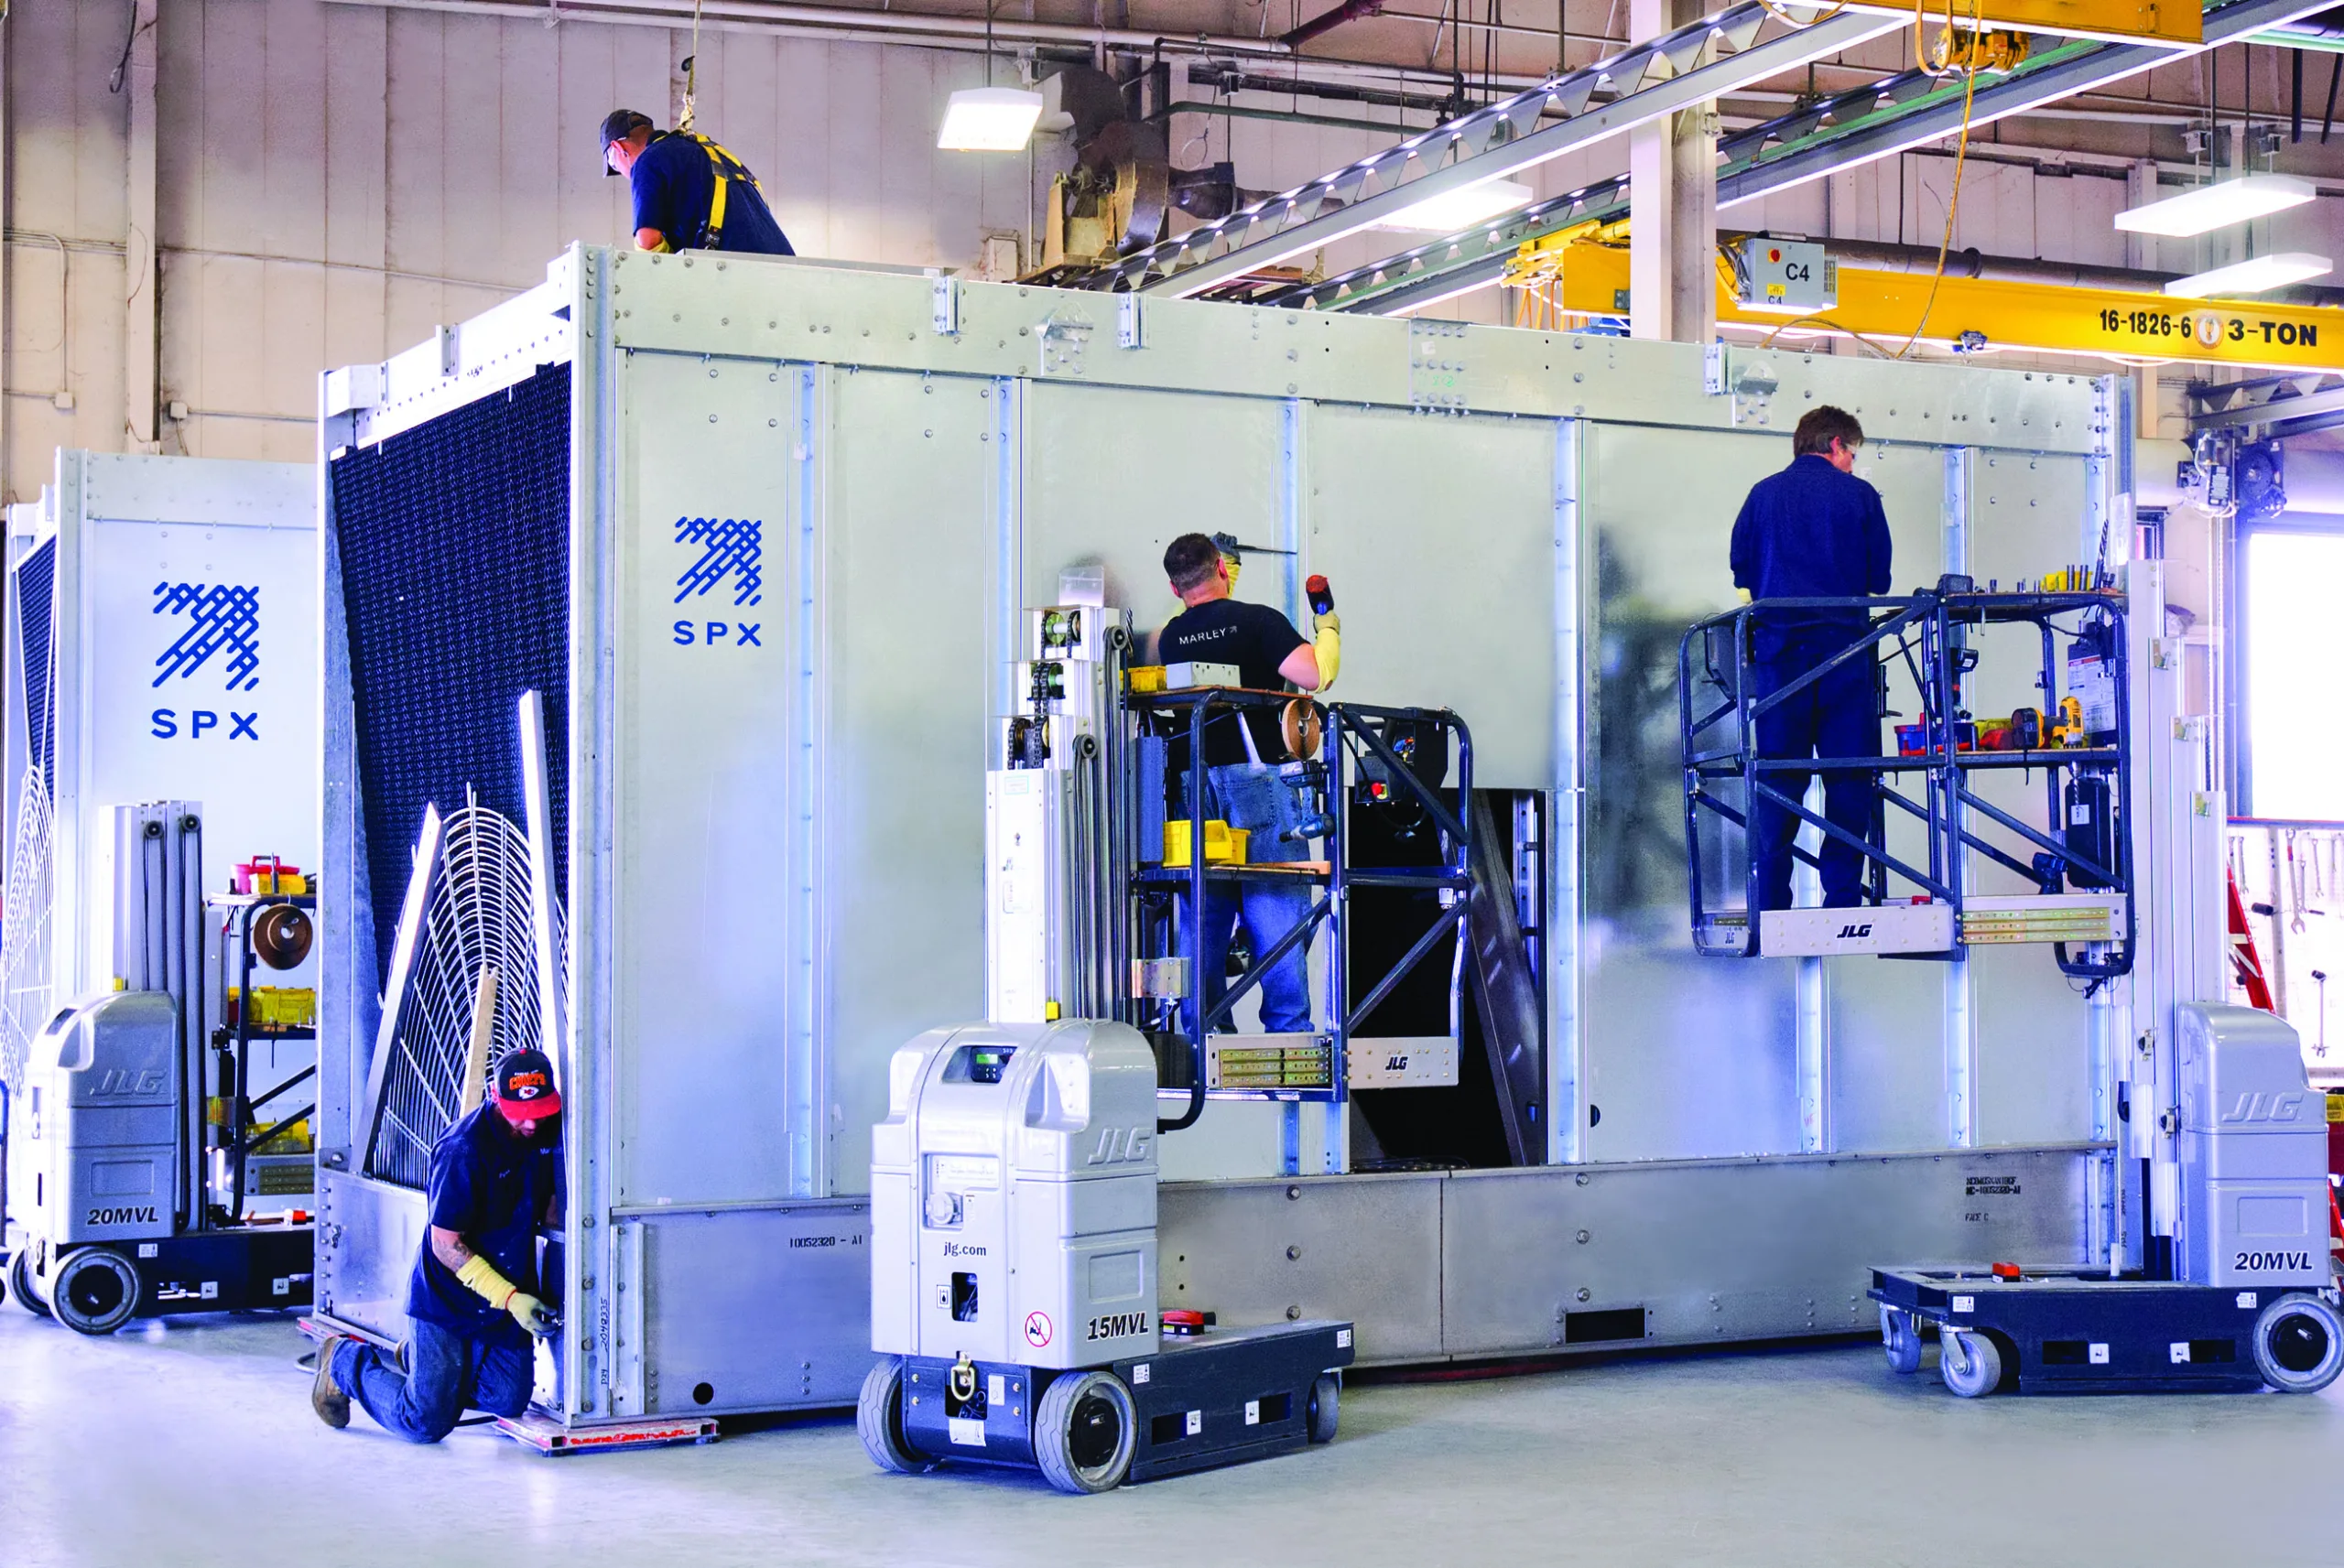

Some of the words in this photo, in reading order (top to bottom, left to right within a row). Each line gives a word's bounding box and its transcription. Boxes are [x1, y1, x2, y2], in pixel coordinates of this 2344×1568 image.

[1785, 263, 1810, 282] C4
[2100, 309, 2192, 339] 16-1826-6
[2228, 319, 2317, 347] 3-TON
[673, 620, 762, 647] SPX
[1178, 627, 1227, 645] MARLEY
[151, 708, 259, 741] SPX
[1836, 924, 1873, 939] JLG
[1384, 1055, 1409, 1071] JLG
[90, 1068, 168, 1097] JLG
[2221, 1091, 2305, 1122] JLG
[1088, 1127, 1153, 1165] JLG
[87, 1206, 159, 1226] 20MVL
[789, 1236, 836, 1249] 10052320
[943, 1240, 987, 1257] jlg.com
[2234, 1251, 2313, 1271] 20MVL
[1087, 1311, 1149, 1342] 15MVL
